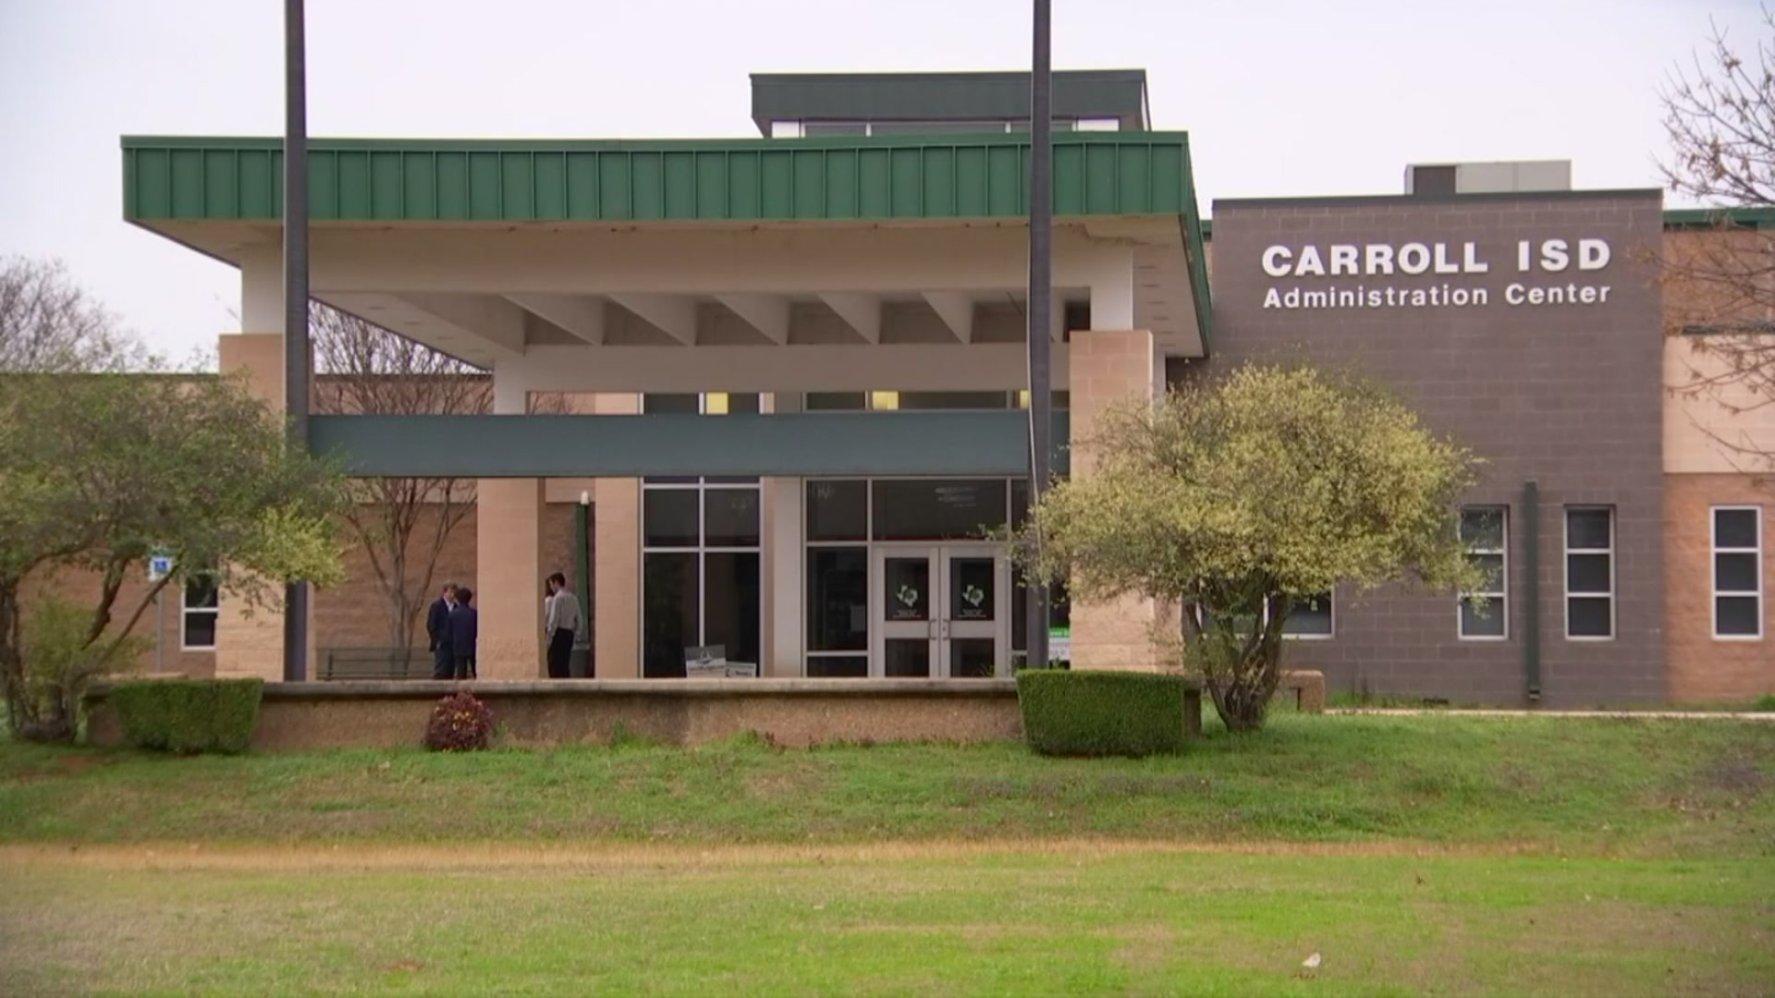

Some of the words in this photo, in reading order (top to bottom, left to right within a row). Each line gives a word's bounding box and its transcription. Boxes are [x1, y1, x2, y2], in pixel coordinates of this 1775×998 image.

[1261, 241, 1488, 276] CARROLL
[1517, 238, 1610, 271] ISD
[1263, 284, 1488, 308] Administration
[1505, 283, 1610, 304] Center
